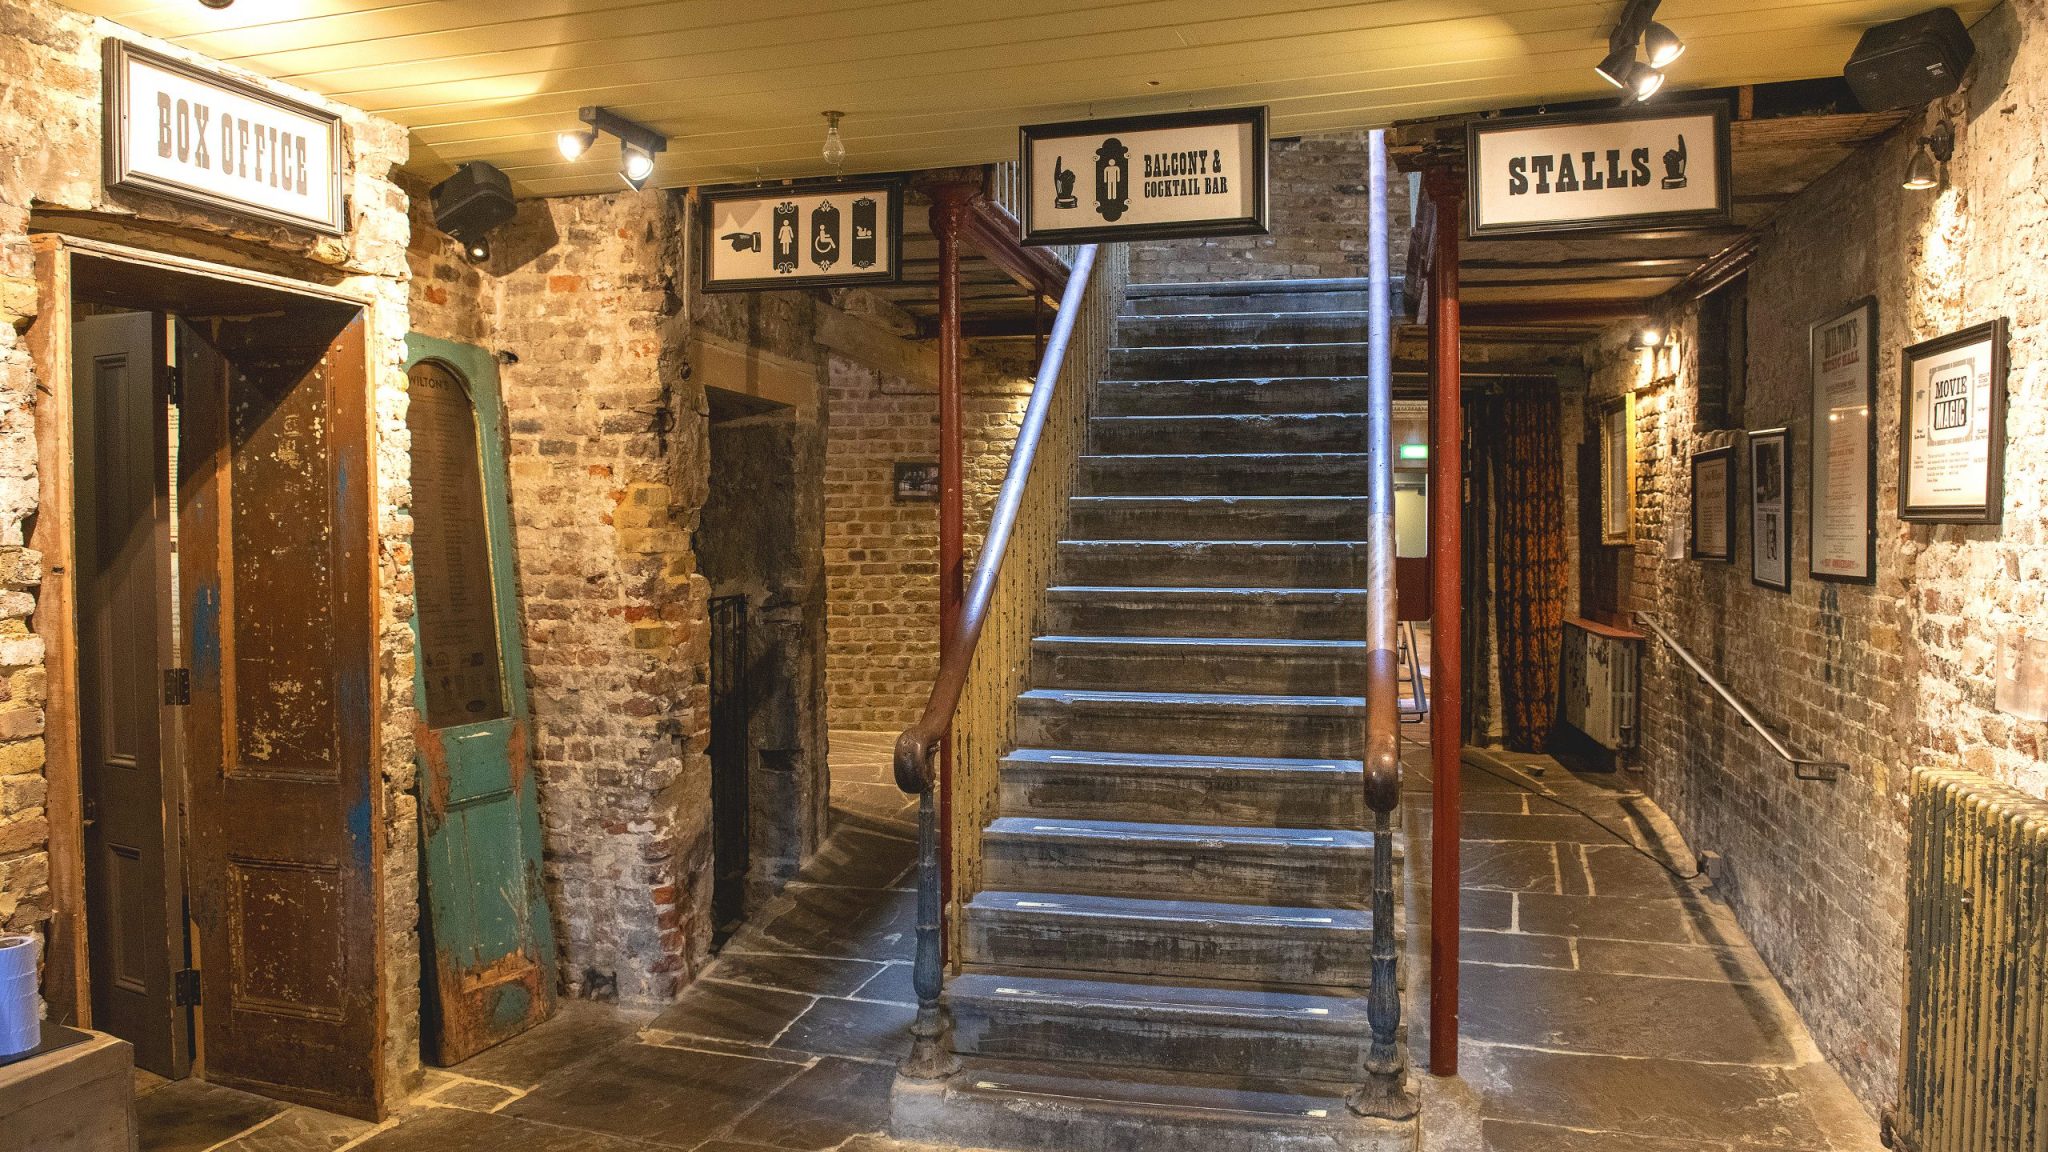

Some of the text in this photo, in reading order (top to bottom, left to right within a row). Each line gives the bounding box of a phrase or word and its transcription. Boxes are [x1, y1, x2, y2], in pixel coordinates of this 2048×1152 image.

[157, 91, 307, 196] BOX OFFICE
[1144, 149, 1222, 178] BALCONY &
[1508, 147, 1651, 196] STALLS
[1144, 176, 1228, 198] COCKTAIL BAR
[1935, 375, 1968, 400] MOVIE
[1936, 399, 1967, 430] MAGIC
